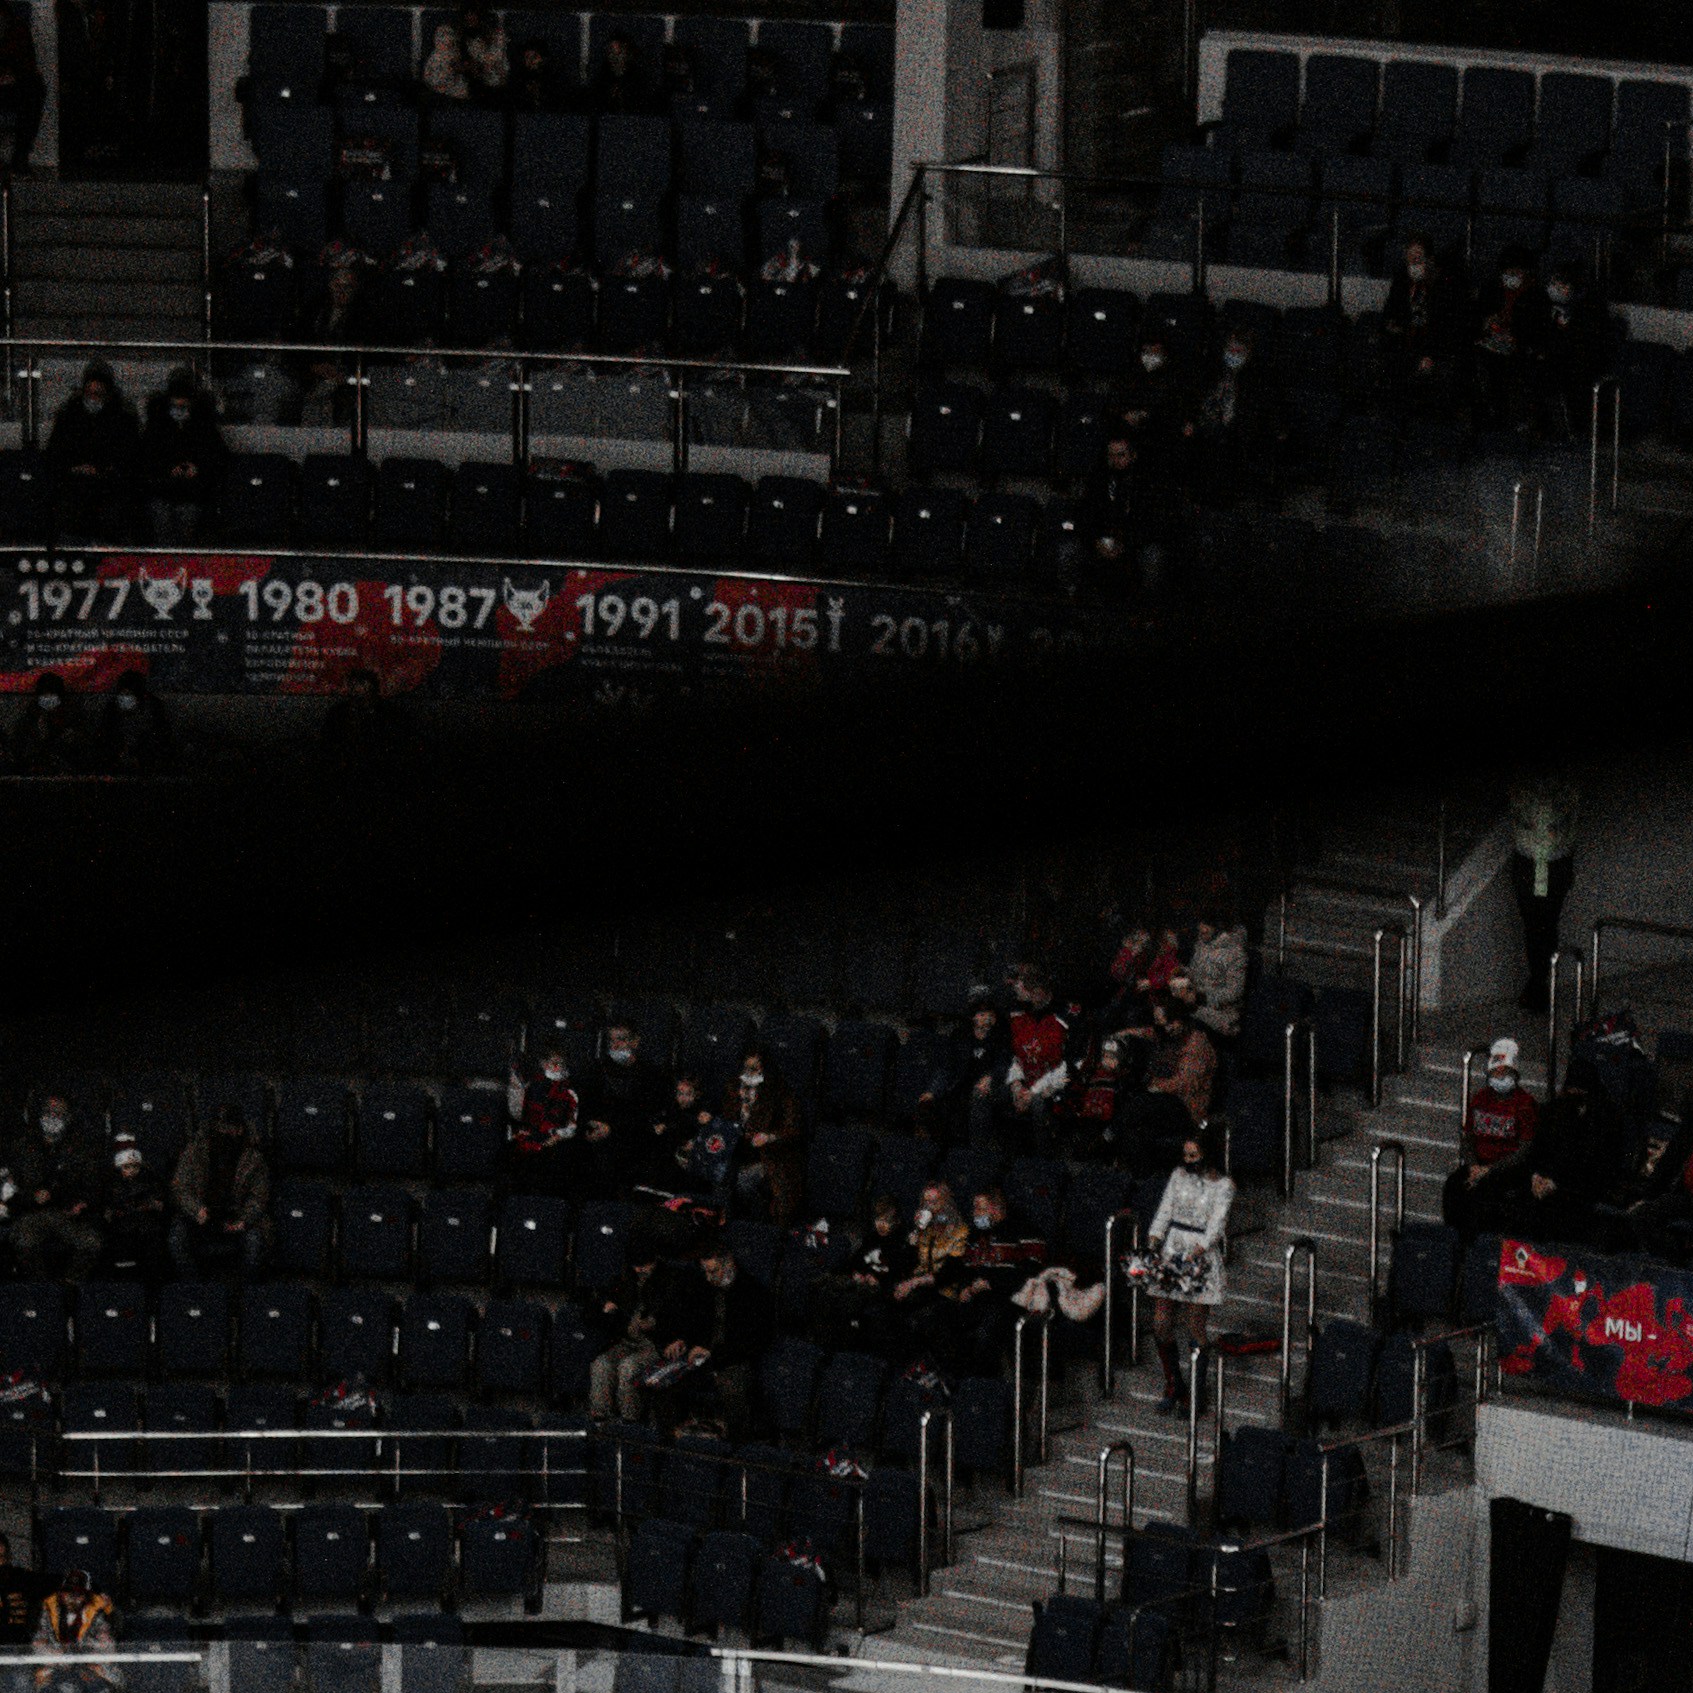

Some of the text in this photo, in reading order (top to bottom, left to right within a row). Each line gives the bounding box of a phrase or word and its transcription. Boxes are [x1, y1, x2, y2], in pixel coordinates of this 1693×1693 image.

[18, 578, 131, 621] 1977
[239, 580, 359, 625] 1980
[384, 584, 497, 630] 1987
[576, 594, 681, 642] 1991
[703, 601, 819, 651] 2015
[870, 613, 980, 662] 2016
[1605, 1317, 1642, 1343] МЫ
